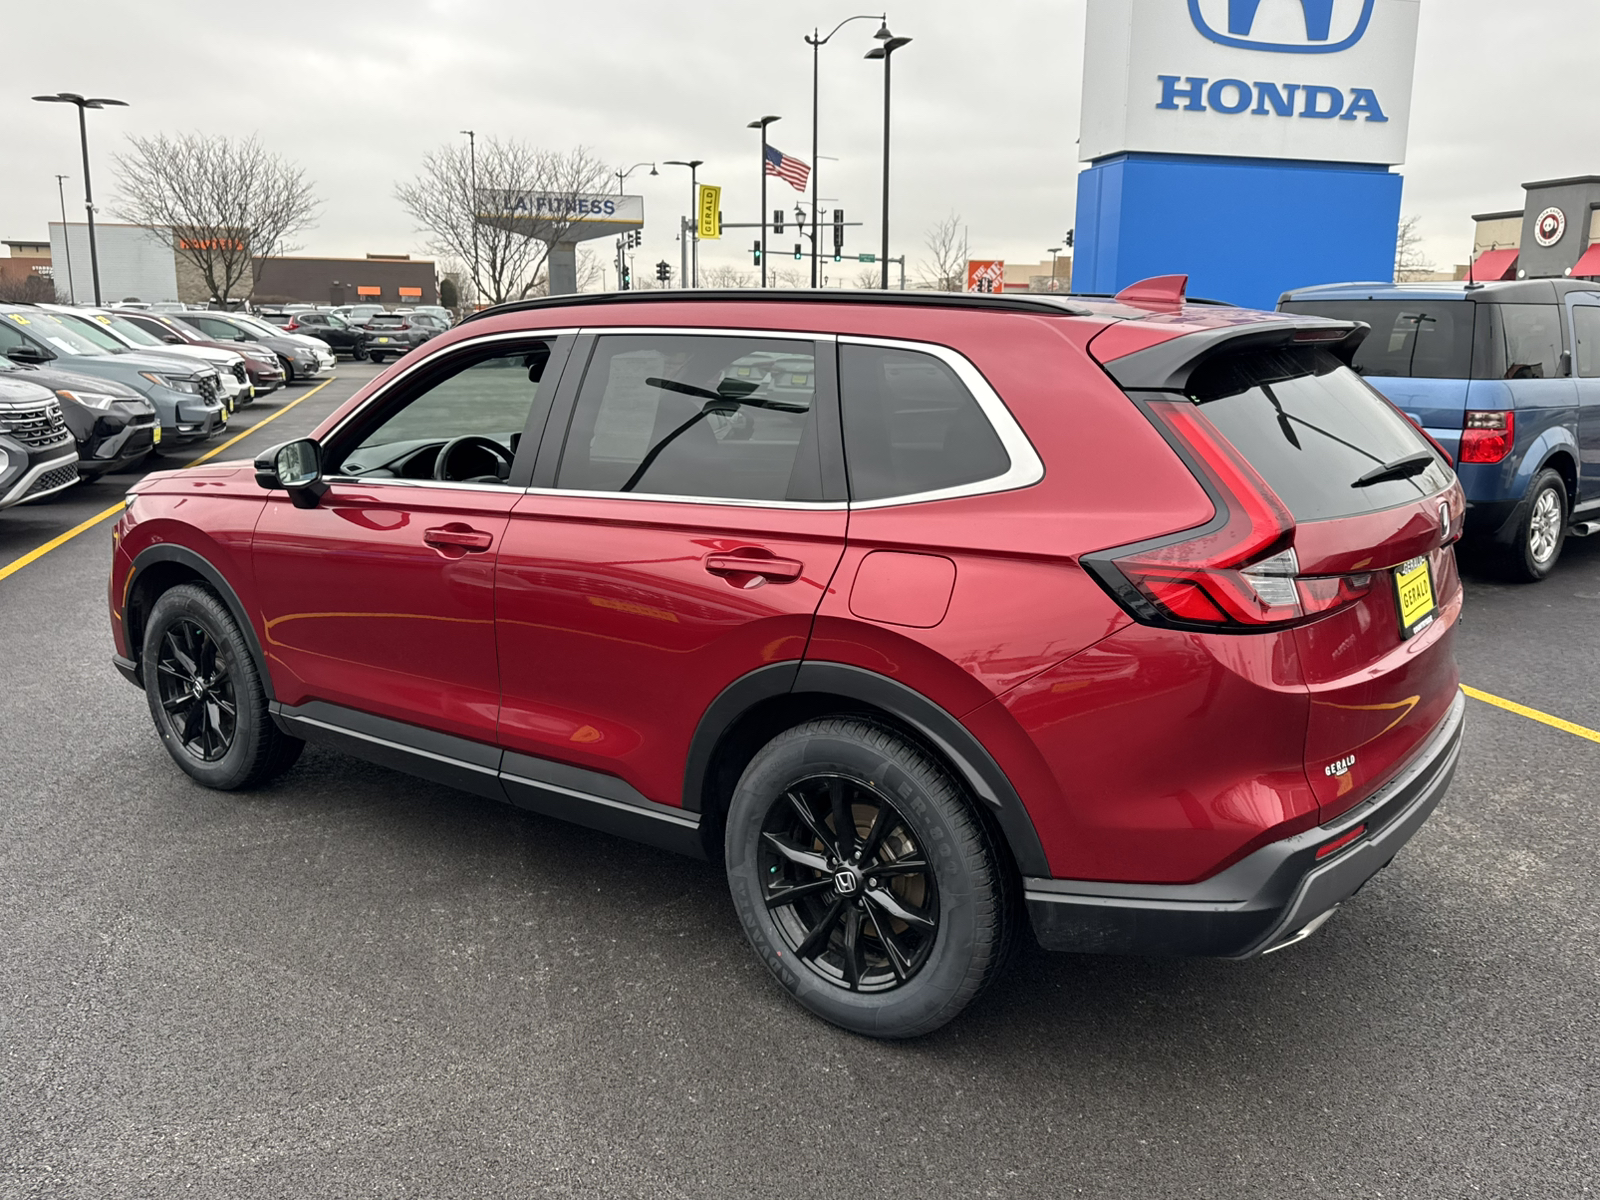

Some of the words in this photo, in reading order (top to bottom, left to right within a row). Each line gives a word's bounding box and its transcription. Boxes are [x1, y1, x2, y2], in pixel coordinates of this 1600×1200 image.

[1156, 75, 1388, 122] HONDA
[503, 196, 528, 211] LA
[536, 197, 615, 215] FITNESS
[704, 191, 713, 233] GERALD
[1403, 579, 1428, 608] GERALD
[1324, 754, 1356, 777] GERALD
